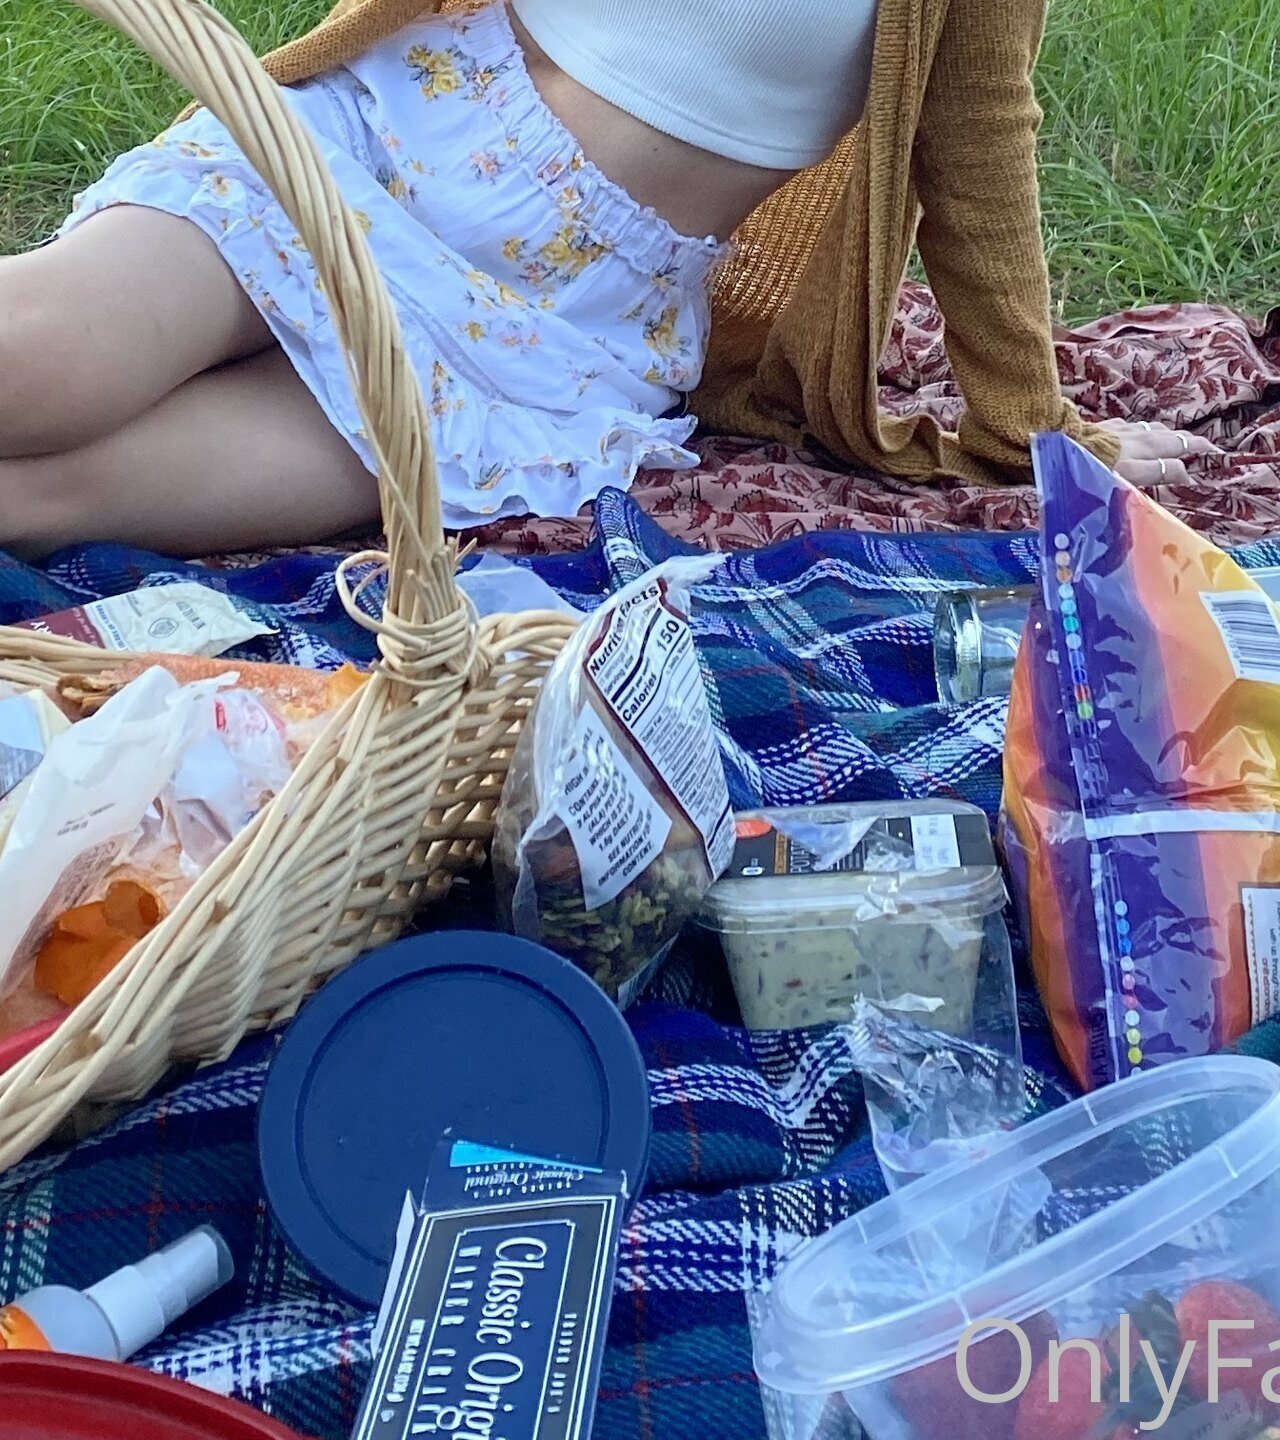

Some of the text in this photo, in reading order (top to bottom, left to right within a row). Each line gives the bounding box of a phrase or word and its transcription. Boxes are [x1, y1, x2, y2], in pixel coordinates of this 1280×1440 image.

[619, 585, 659, 618] Facts
[656, 619, 680, 652] 150
[622, 672, 658, 723] Calories
[464, 1171, 529, 1192] Original
[440, 1246, 482, 1327] WATER
[475, 1237, 548, 1345] Classic
[546, 1312, 578, 1413] TRADER JOE'S
